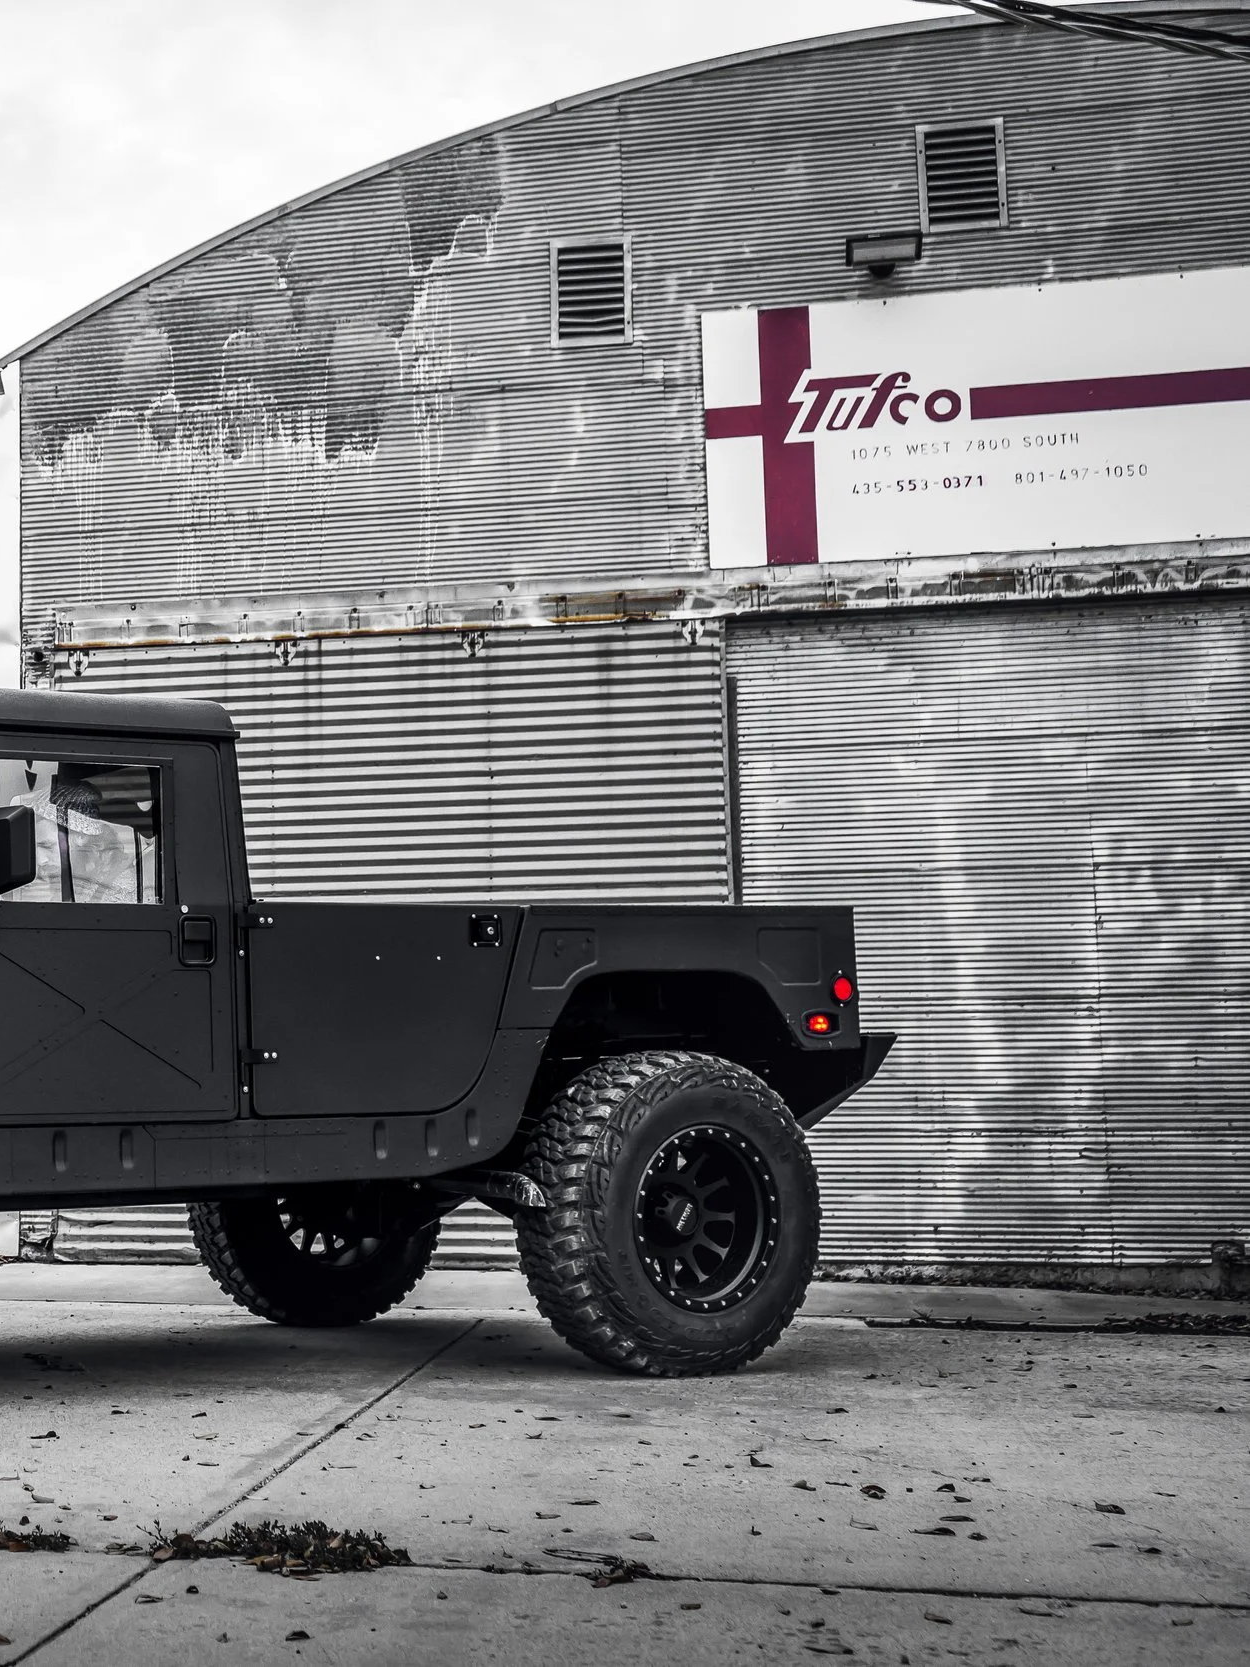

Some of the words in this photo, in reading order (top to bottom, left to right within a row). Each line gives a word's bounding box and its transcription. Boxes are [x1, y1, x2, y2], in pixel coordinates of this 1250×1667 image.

[798, 371, 962, 433] Tufco
[851, 446, 893, 461] 1075
[906, 441, 952, 457] WEST
[965, 438, 1011, 453] 7800
[1023, 432, 1080, 448] SOUTH
[851, 475, 985, 495] 435-553-0371
[1015, 463, 1148, 485] 801-497-1050
